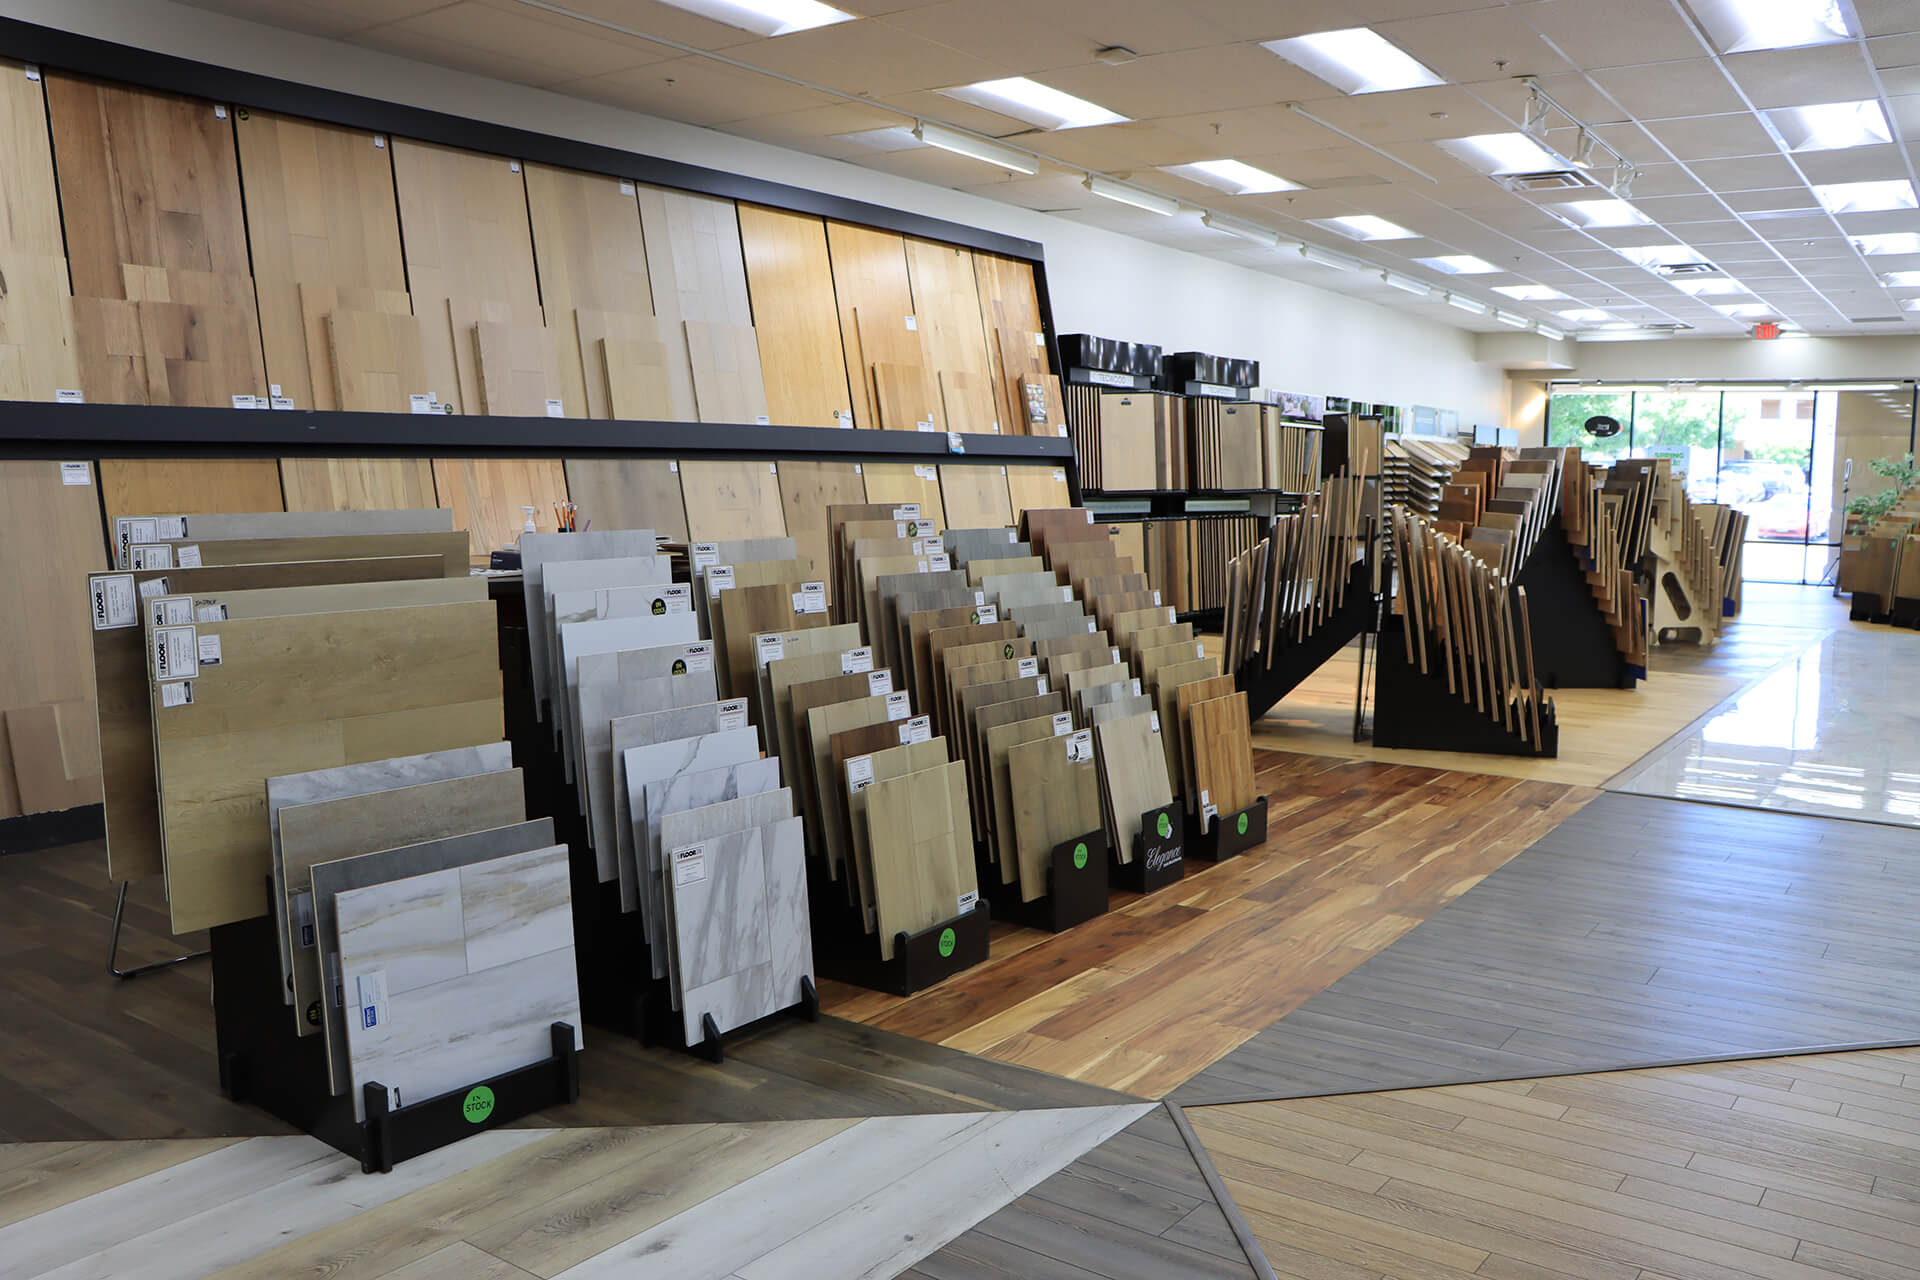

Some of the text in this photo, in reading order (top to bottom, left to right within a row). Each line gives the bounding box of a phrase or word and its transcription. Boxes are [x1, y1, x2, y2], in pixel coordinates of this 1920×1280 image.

[1756, 325, 1777, 340] EXIT
[96, 592, 105, 619] FLOOR
[466, 1100, 491, 1113] STOCK
